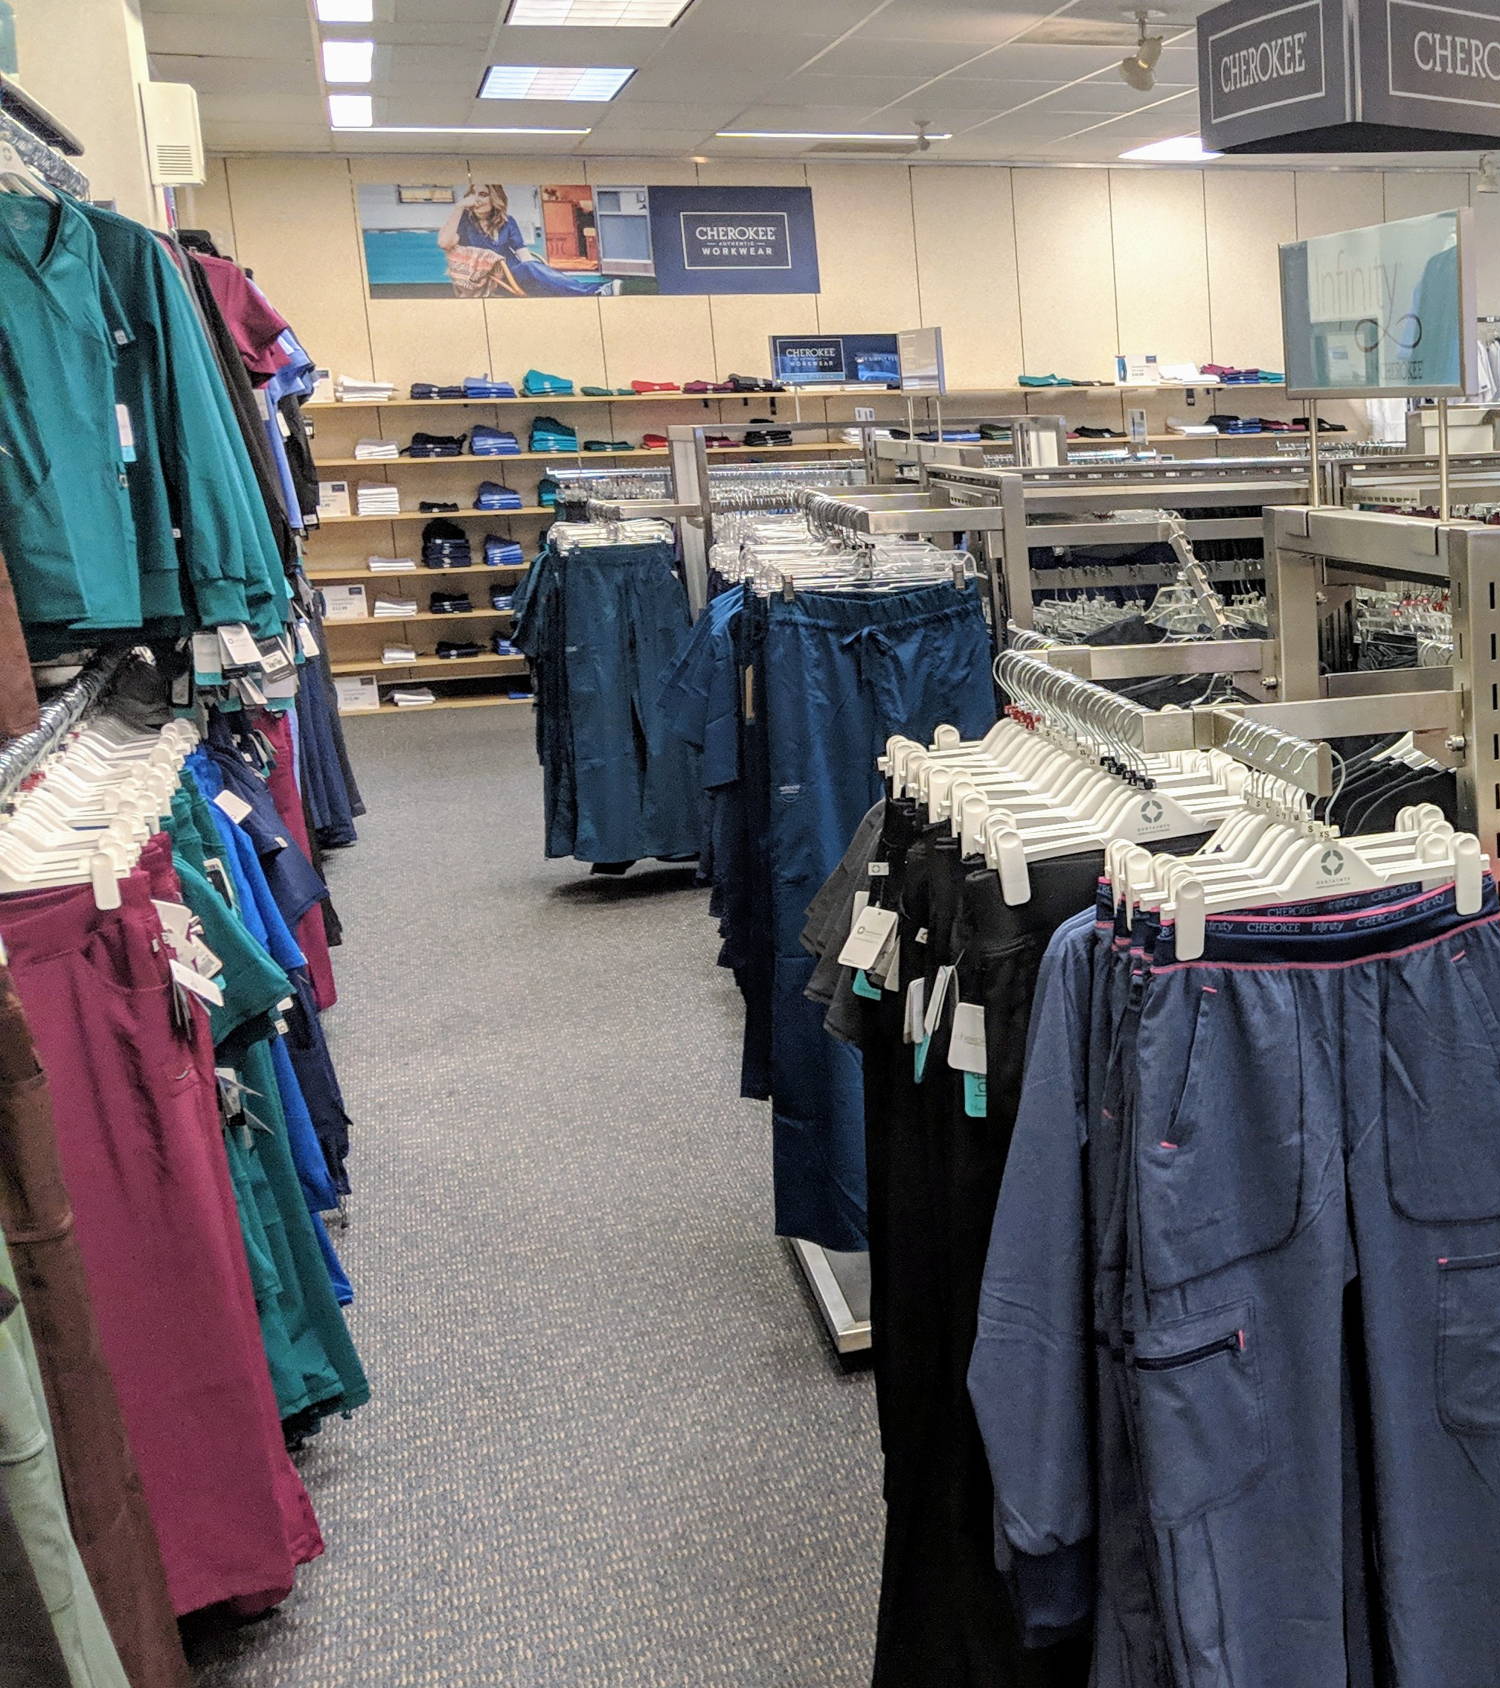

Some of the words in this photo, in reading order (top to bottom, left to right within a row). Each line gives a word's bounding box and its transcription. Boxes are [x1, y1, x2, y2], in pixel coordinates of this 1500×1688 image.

[1220, 31, 1307, 94] CHEROKEE
[695, 226, 777, 241] CHEROKEE
[701, 247, 774, 256] WORKWEAR
[786, 347, 836, 358] CHEROKEE
[1247, 922, 1301, 933] CHEROKEE
[1356, 910, 1406, 929] CHEROKEE
